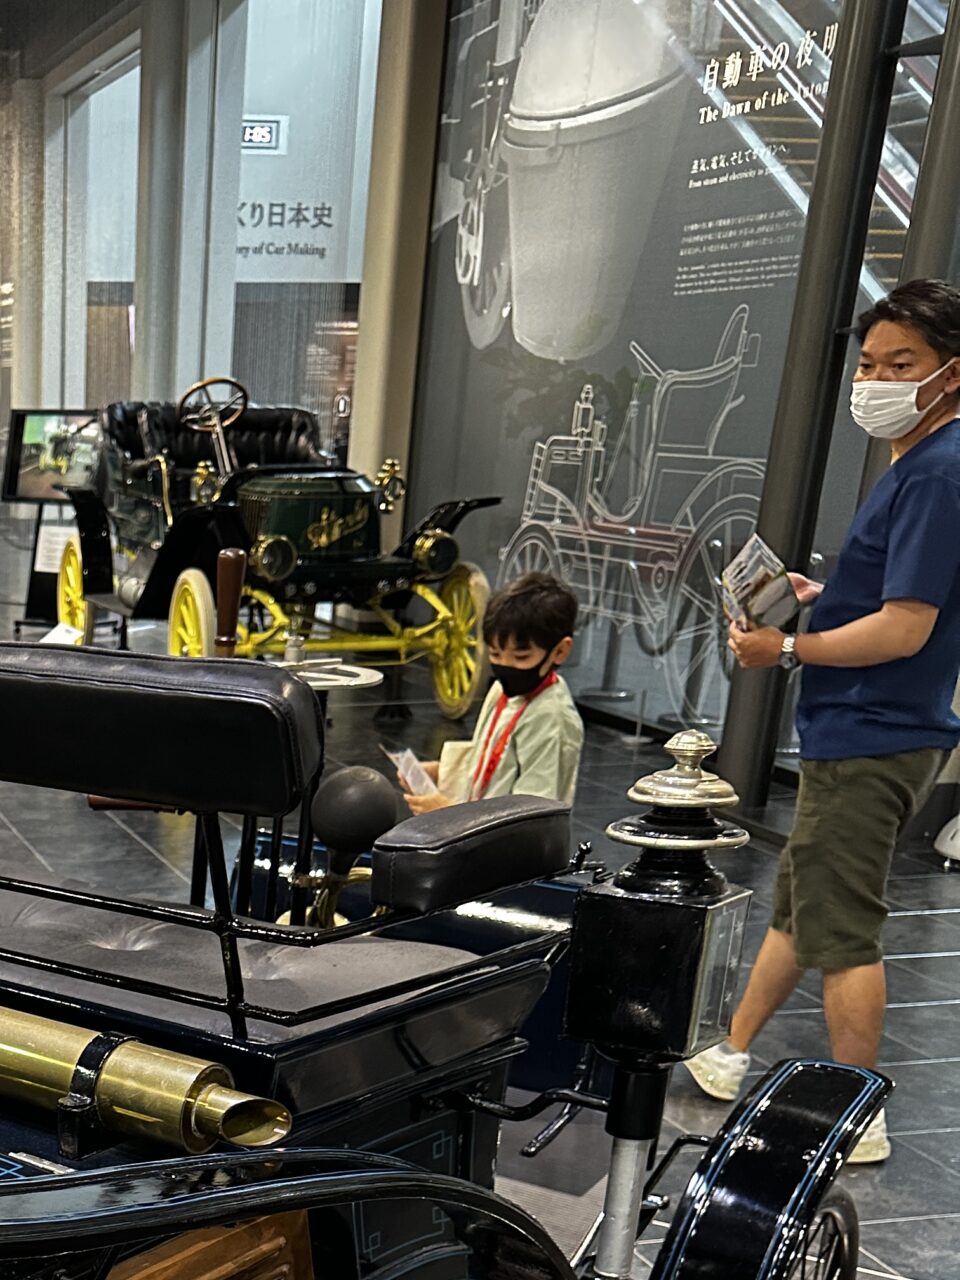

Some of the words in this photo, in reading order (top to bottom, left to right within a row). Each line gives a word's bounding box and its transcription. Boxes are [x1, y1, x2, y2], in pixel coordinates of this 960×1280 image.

[698, 106, 719, 125] The
[722, 100, 751, 119] Dawn
[754, 91, 769, 111] of
[771, 88, 790, 105] the
[265, 242, 285, 255] Car
[287, 242, 327, 259] Making
